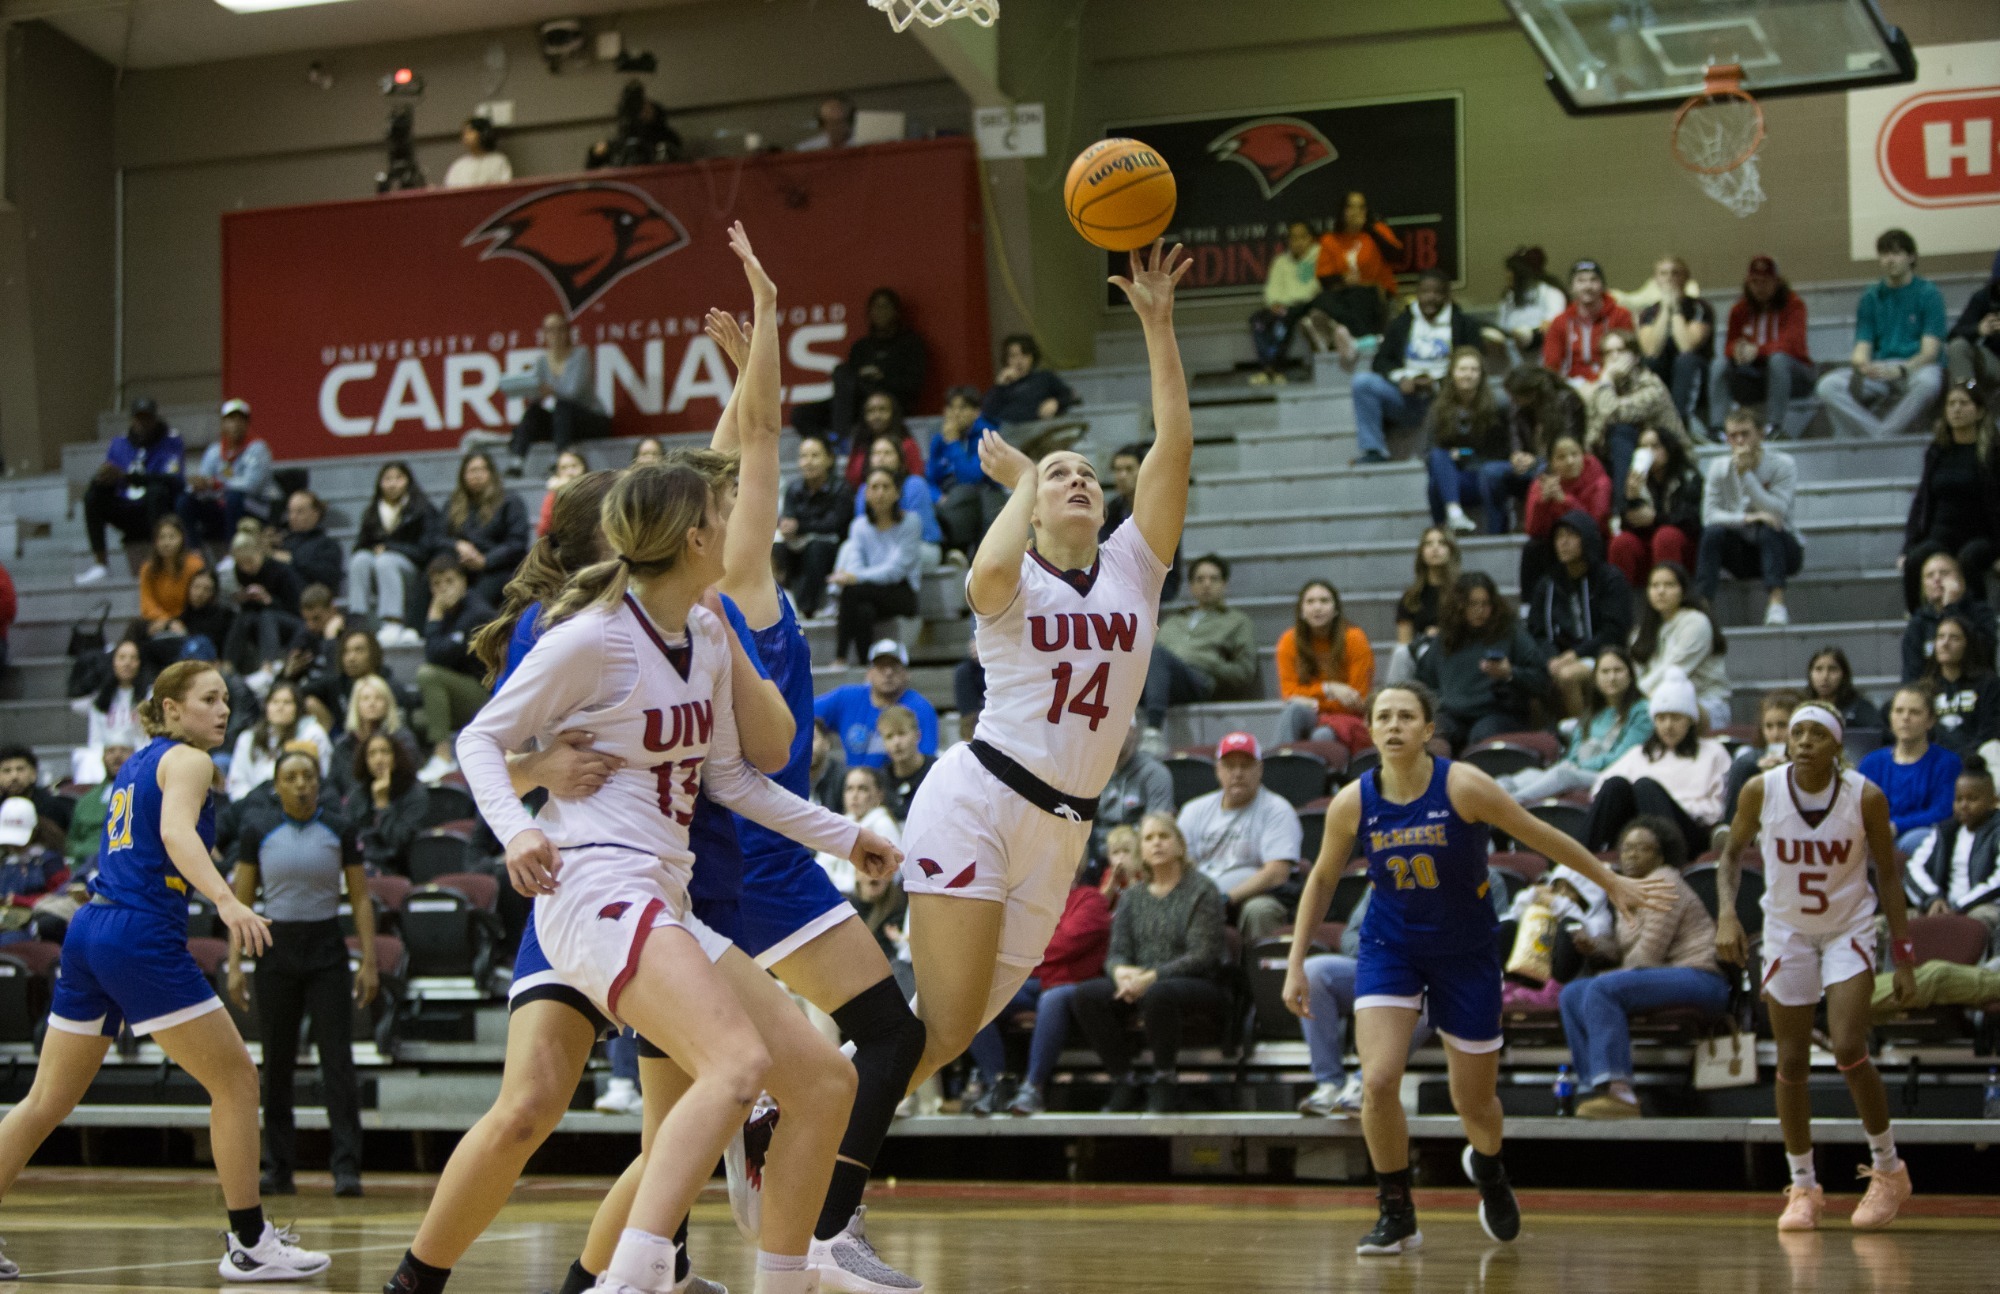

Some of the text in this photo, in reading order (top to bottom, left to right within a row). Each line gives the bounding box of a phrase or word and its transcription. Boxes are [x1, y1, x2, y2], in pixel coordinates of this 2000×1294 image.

[1087, 150, 1162, 187] Wilson
[320, 333, 476, 366] UNIVERSITY
[487, 329, 520, 351] OF
[1027, 612, 1138, 653] UIW
[1046, 661, 1111, 732] 14
[107, 783, 135, 855] 21
[1386, 853, 1440, 890] 20
[1775, 838, 1853, 866] UIW
[1798, 872, 1830, 915] 5
